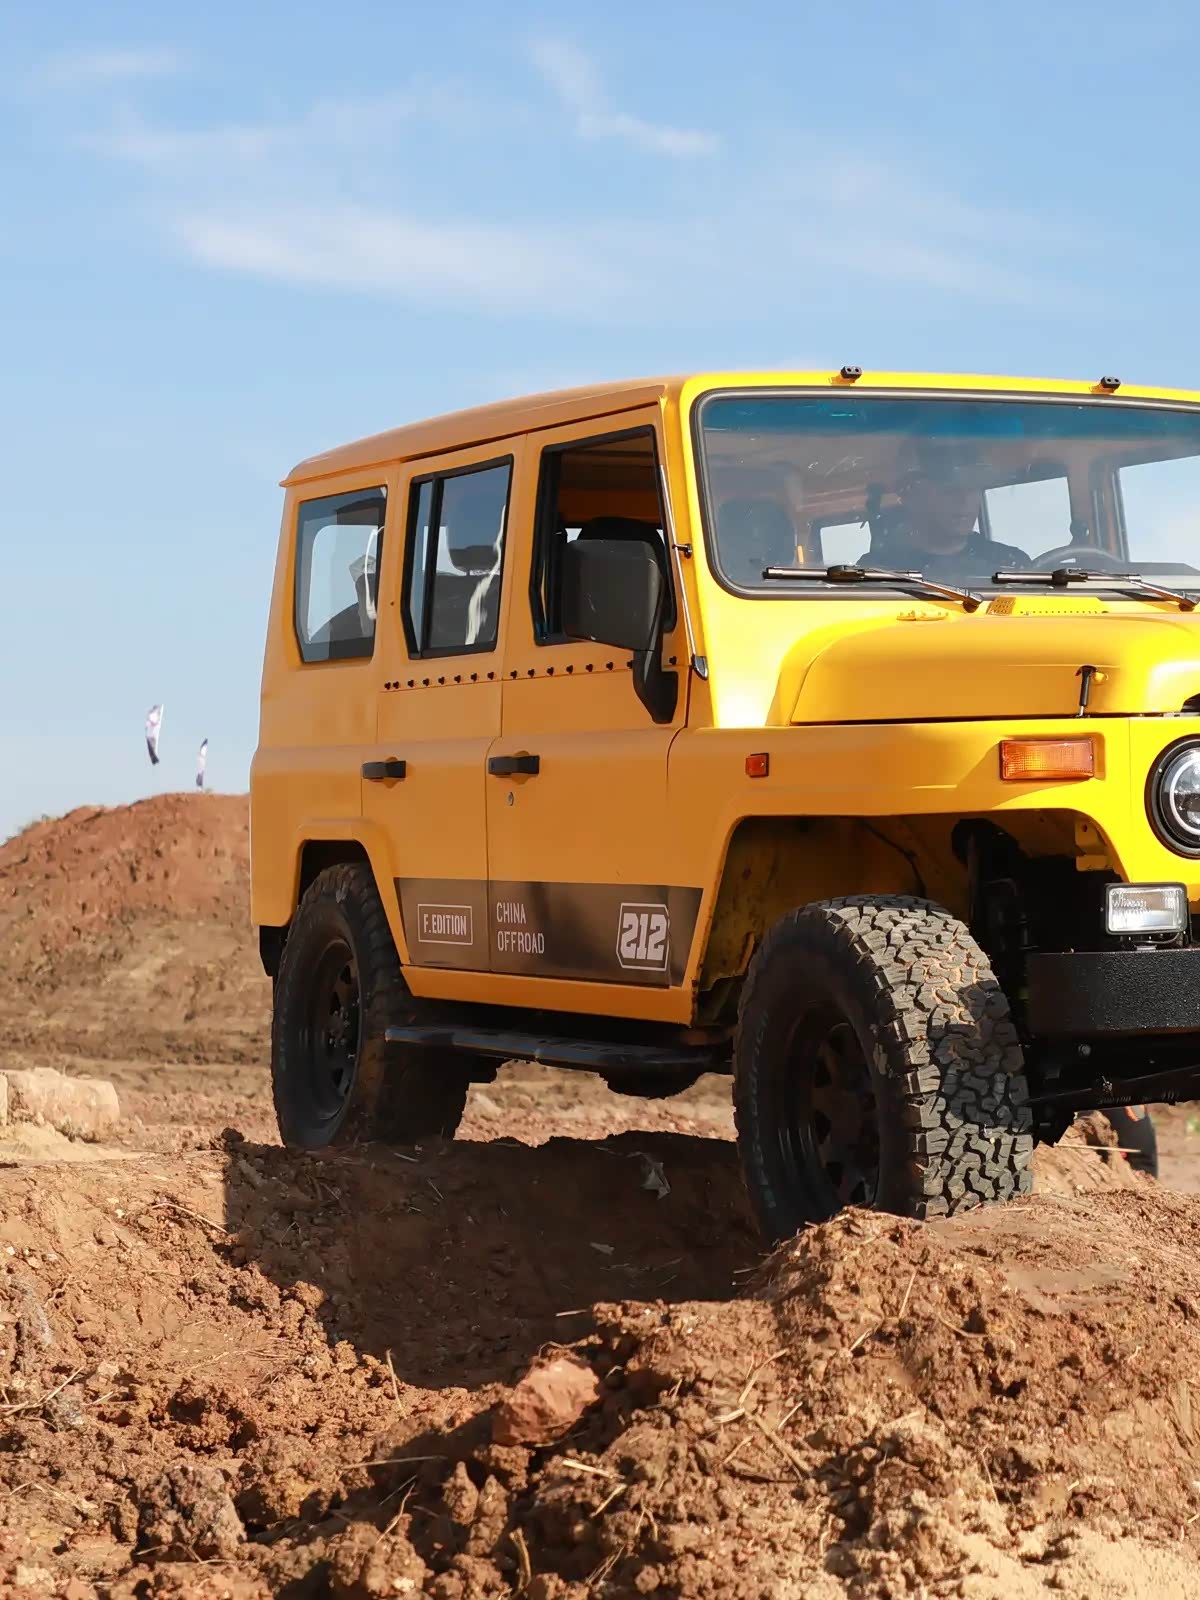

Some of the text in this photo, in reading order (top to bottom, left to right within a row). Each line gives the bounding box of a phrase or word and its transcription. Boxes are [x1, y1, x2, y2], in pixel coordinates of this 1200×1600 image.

[423, 913, 467, 936] F.EDITION
[496, 902, 527, 924] CHINA
[497, 931, 545, 954] OFFROAD
[621, 913, 667, 961] 212
